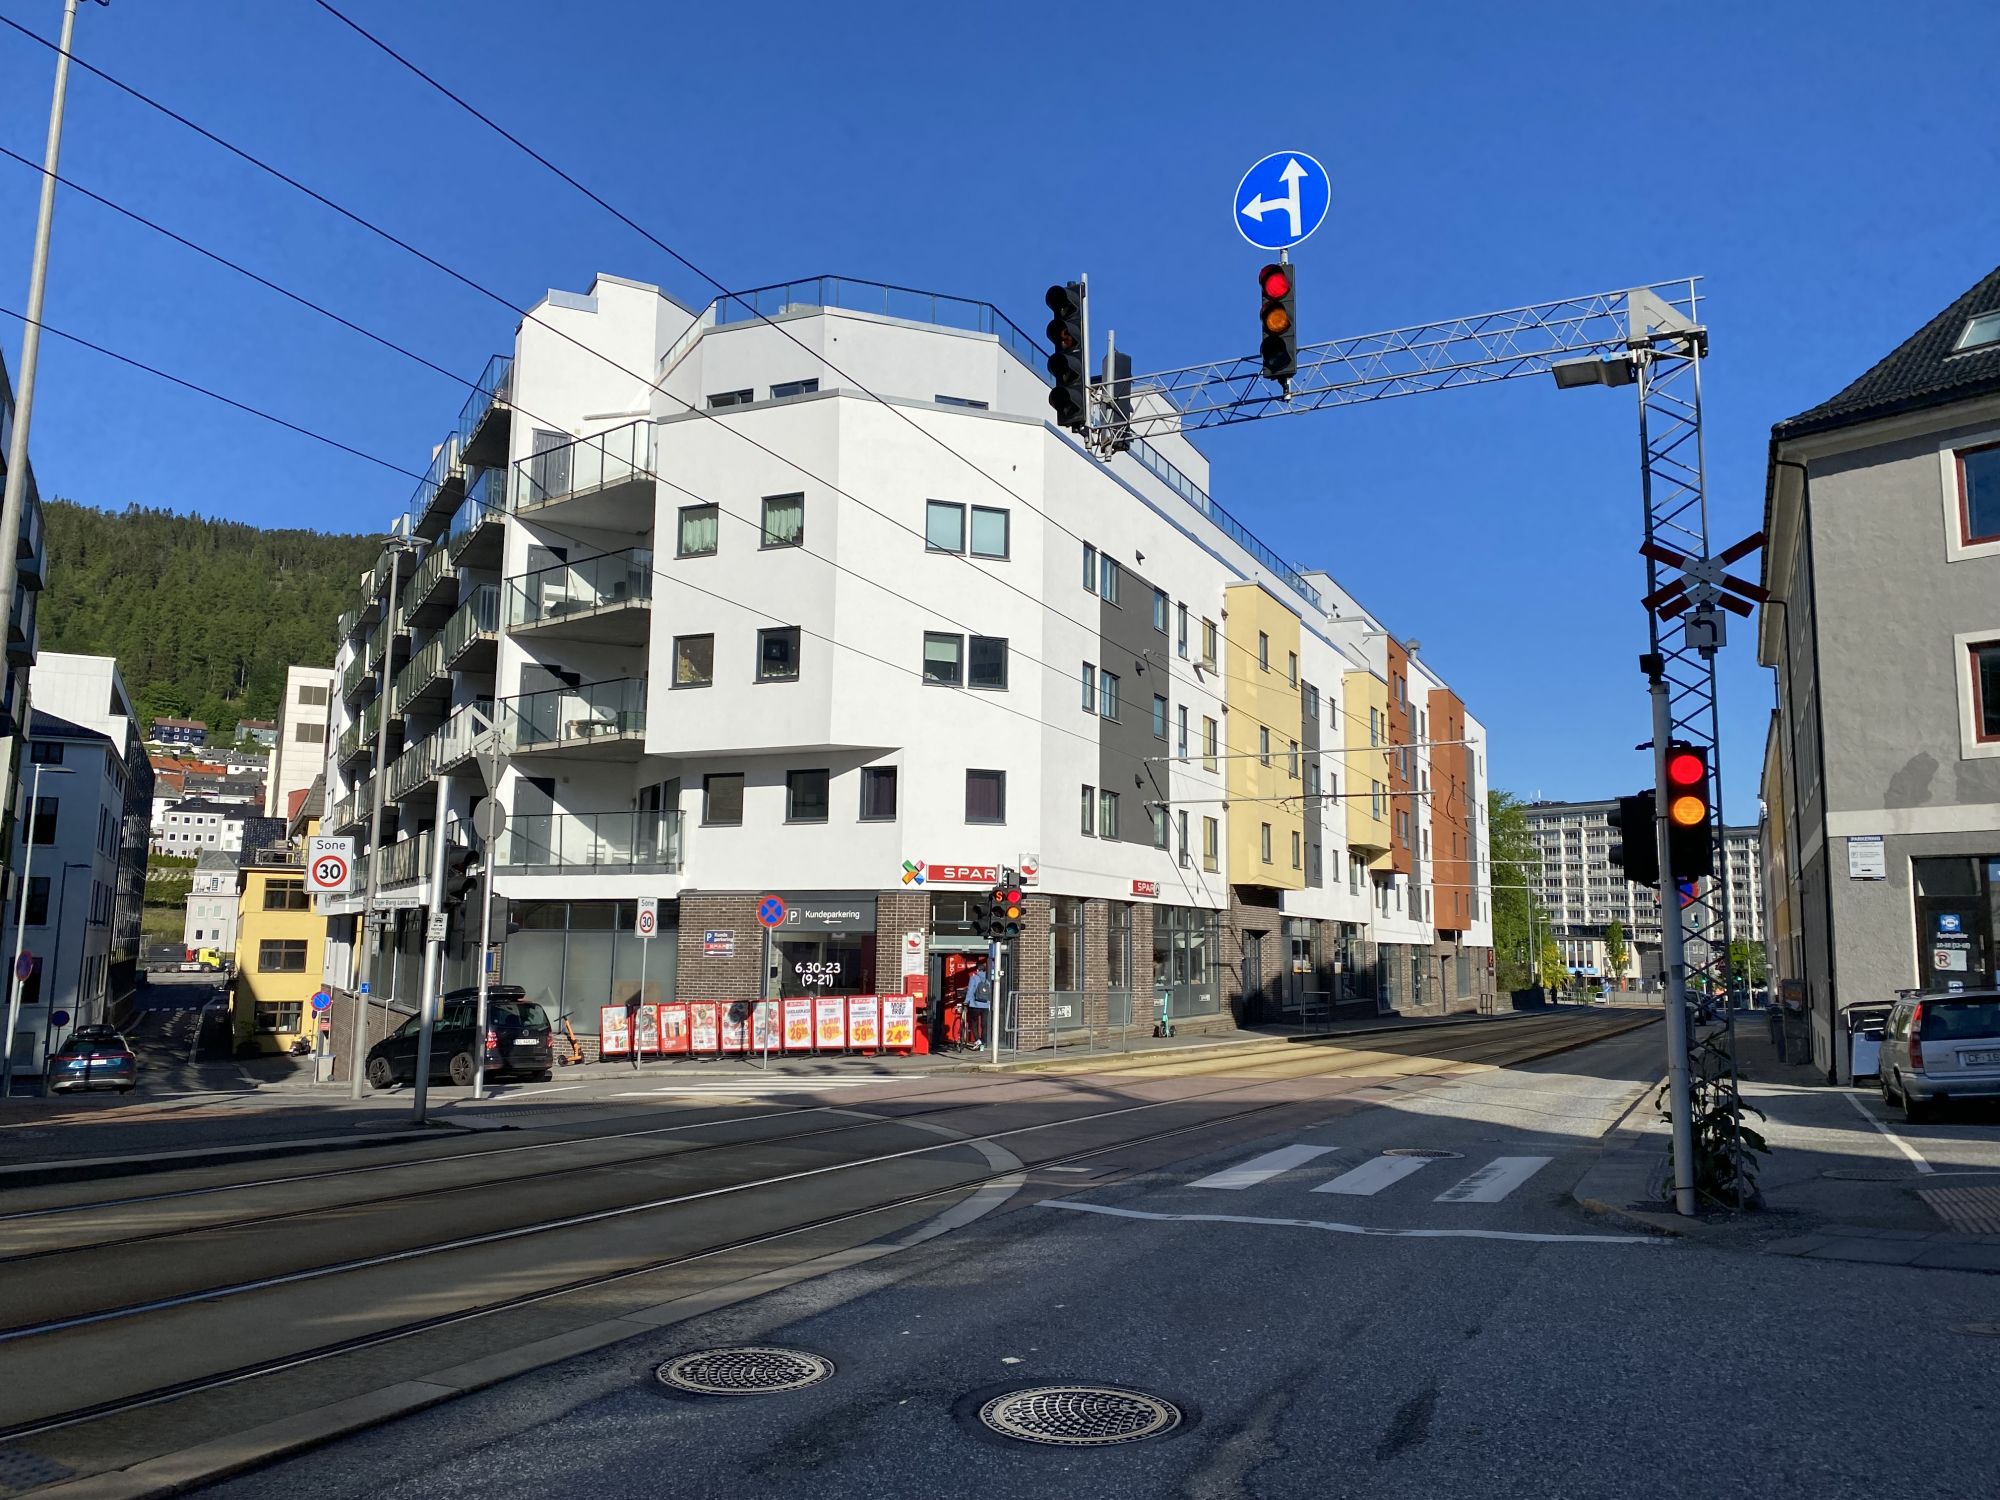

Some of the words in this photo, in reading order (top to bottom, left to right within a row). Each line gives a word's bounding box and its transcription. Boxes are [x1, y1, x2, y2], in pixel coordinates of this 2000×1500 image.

[316, 840, 346, 850] Sone
[319, 864, 341, 879] 30
[943, 867, 996, 879] SPAR
[1137, 882, 1154, 892] SPAR
[790, 911, 798, 921] P
[805, 910, 860, 920] Kundeparkering
[642, 917, 651, 928] 30
[795, 962, 841, 974] 6.30-23
[801, 974, 834, 987] (9-21)
